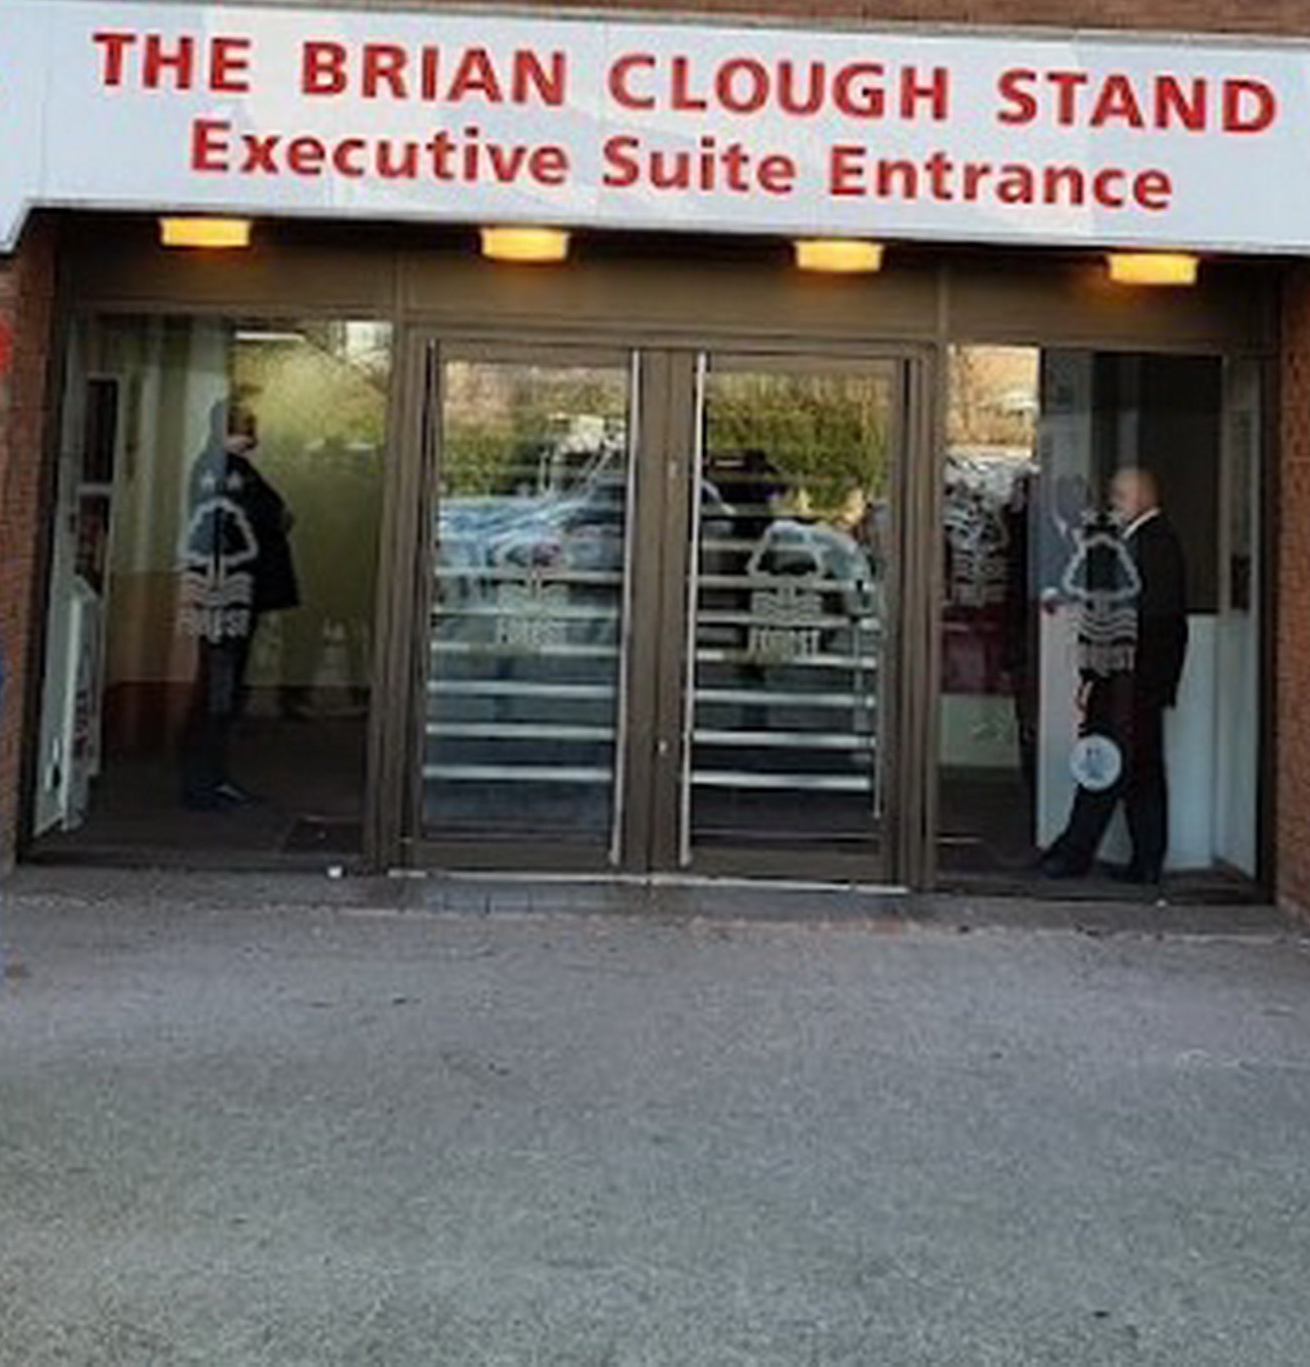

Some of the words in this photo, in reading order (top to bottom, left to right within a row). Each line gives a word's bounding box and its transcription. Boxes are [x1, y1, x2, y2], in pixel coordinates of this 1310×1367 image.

[92, 33, 251, 93] THE
[300, 41, 568, 108] BRIAN
[606, 52, 950, 120] CLOUGH
[996, 68, 1279, 134] STAND
[190, 118, 568, 186] Executive
[601, 135, 798, 195] Suite
[830, 144, 1173, 211] Entrance
